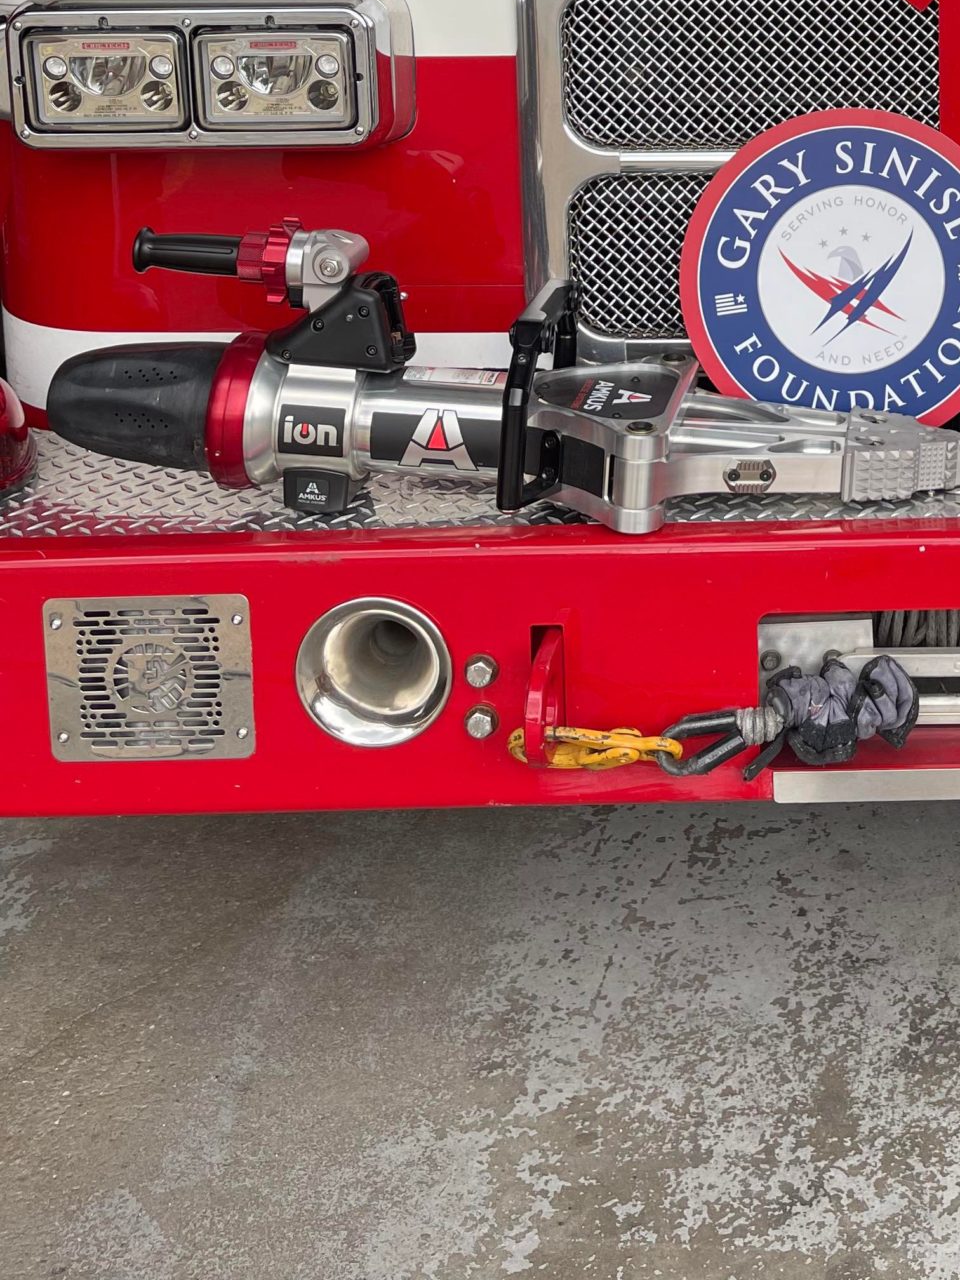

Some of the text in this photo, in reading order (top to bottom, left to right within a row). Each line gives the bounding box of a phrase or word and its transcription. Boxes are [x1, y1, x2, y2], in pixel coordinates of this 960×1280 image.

[717, 149, 811, 269] GARY
[781, 195, 908, 241] SERVING HONOR
[815, 341, 905, 366] AND NEED
[583, 380, 615, 411] AMKUS
[284, 415, 338, 447] ion
[298, 492, 327, 501] AMKUS
